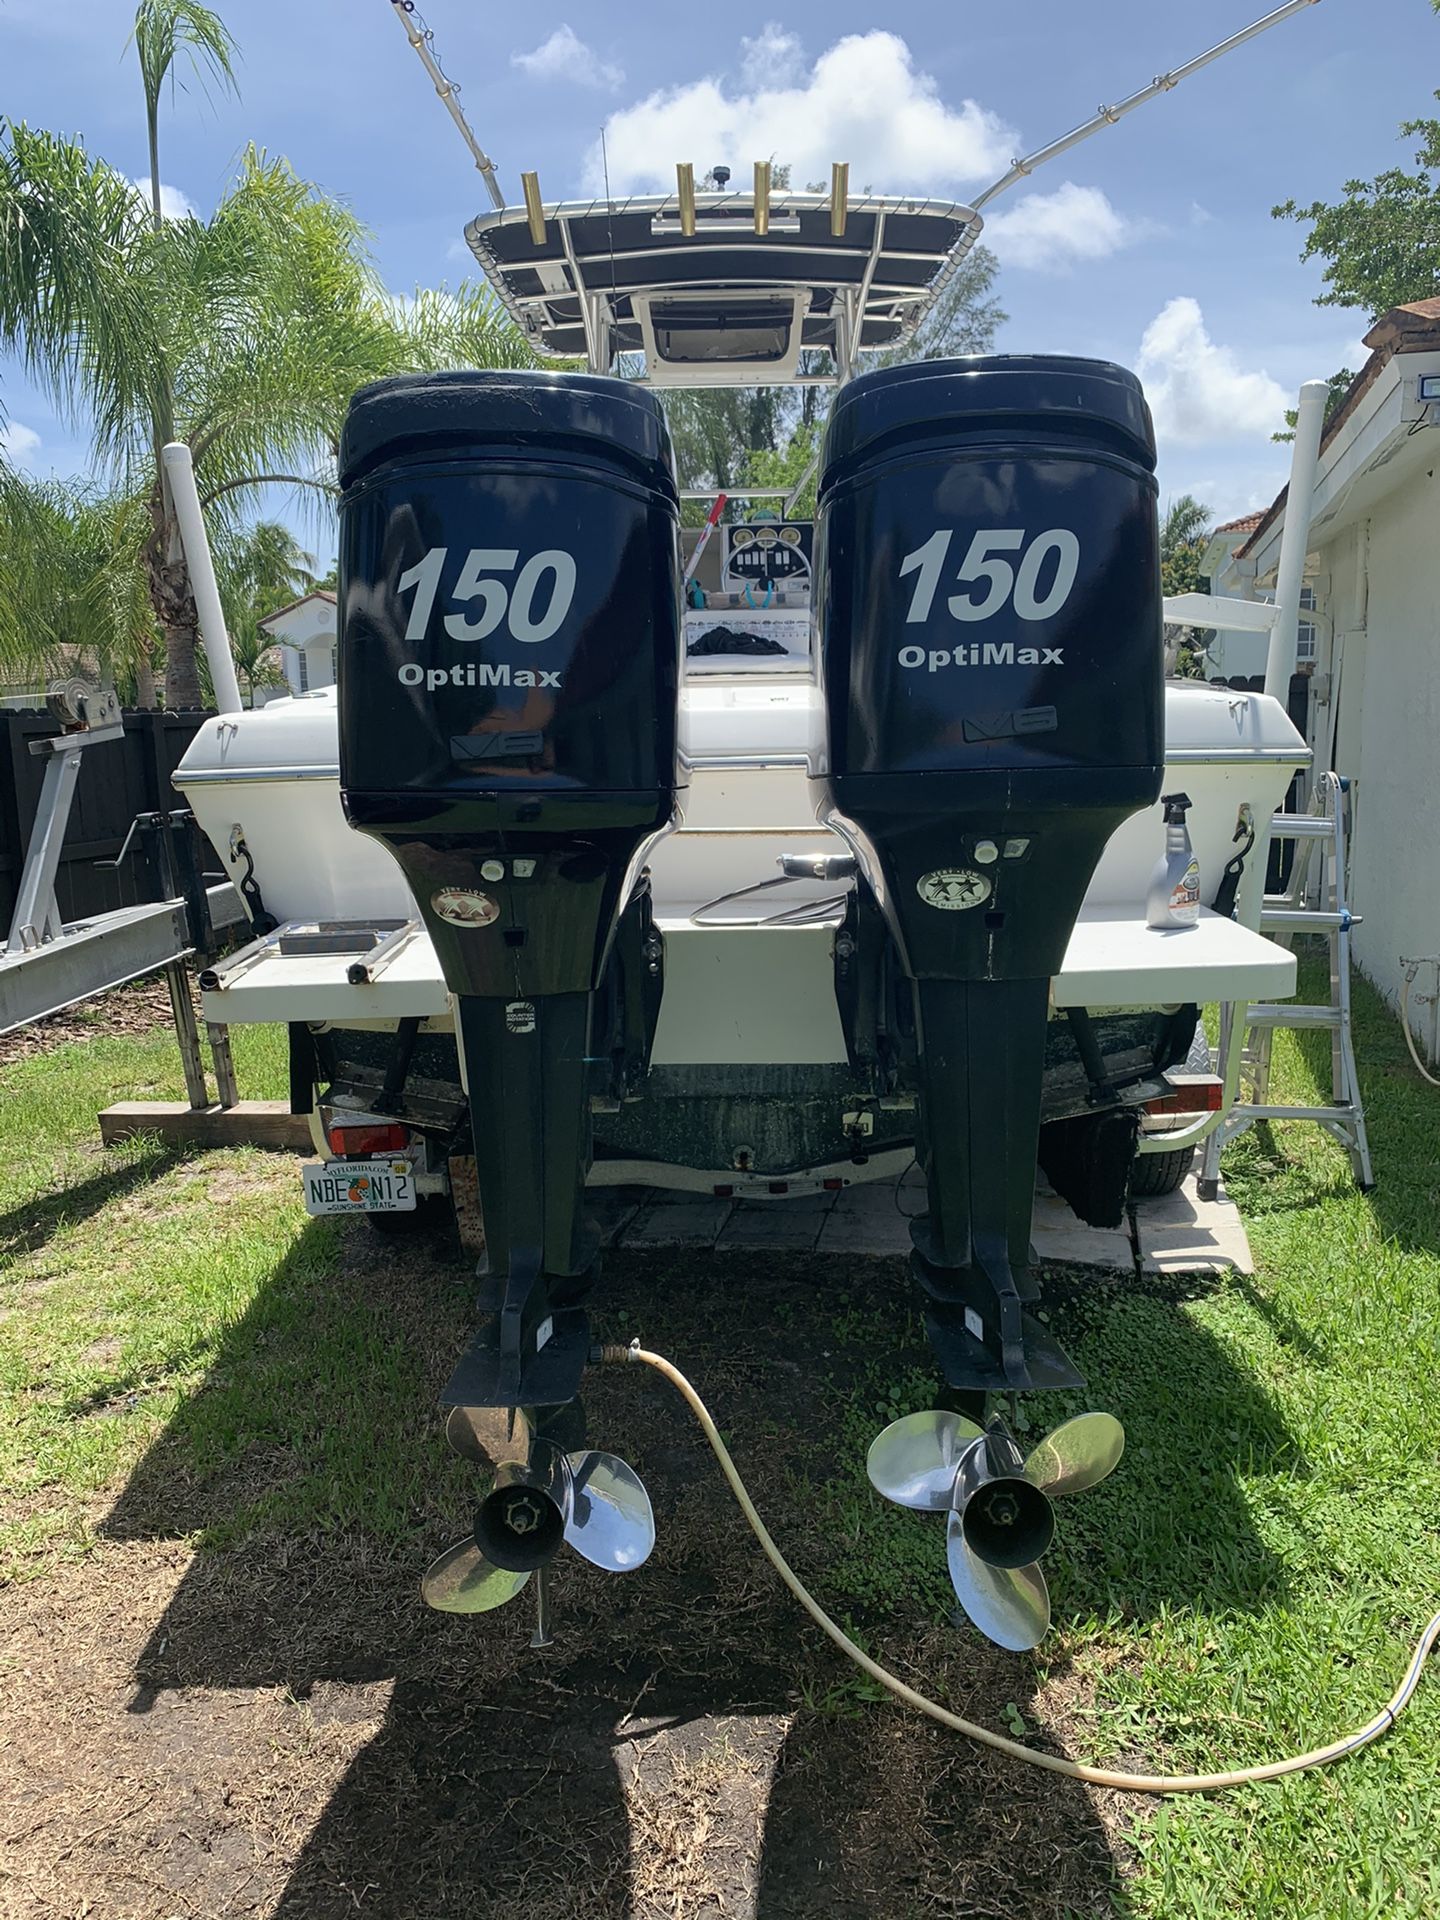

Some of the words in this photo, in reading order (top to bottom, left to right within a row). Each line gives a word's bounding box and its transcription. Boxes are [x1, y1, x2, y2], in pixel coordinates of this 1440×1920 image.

[897, 529, 1080, 623] 150
[397, 547, 577, 643] 150
[898, 642, 1065, 672] OptiMax
[397, 663, 563, 691] OptiMax
[310, 1178, 347, 1204] NBE
[371, 1175, 408, 1200] N12
[332, 1202, 367, 1210] SUNSHINE
[370, 1201, 392, 1209] STATE
